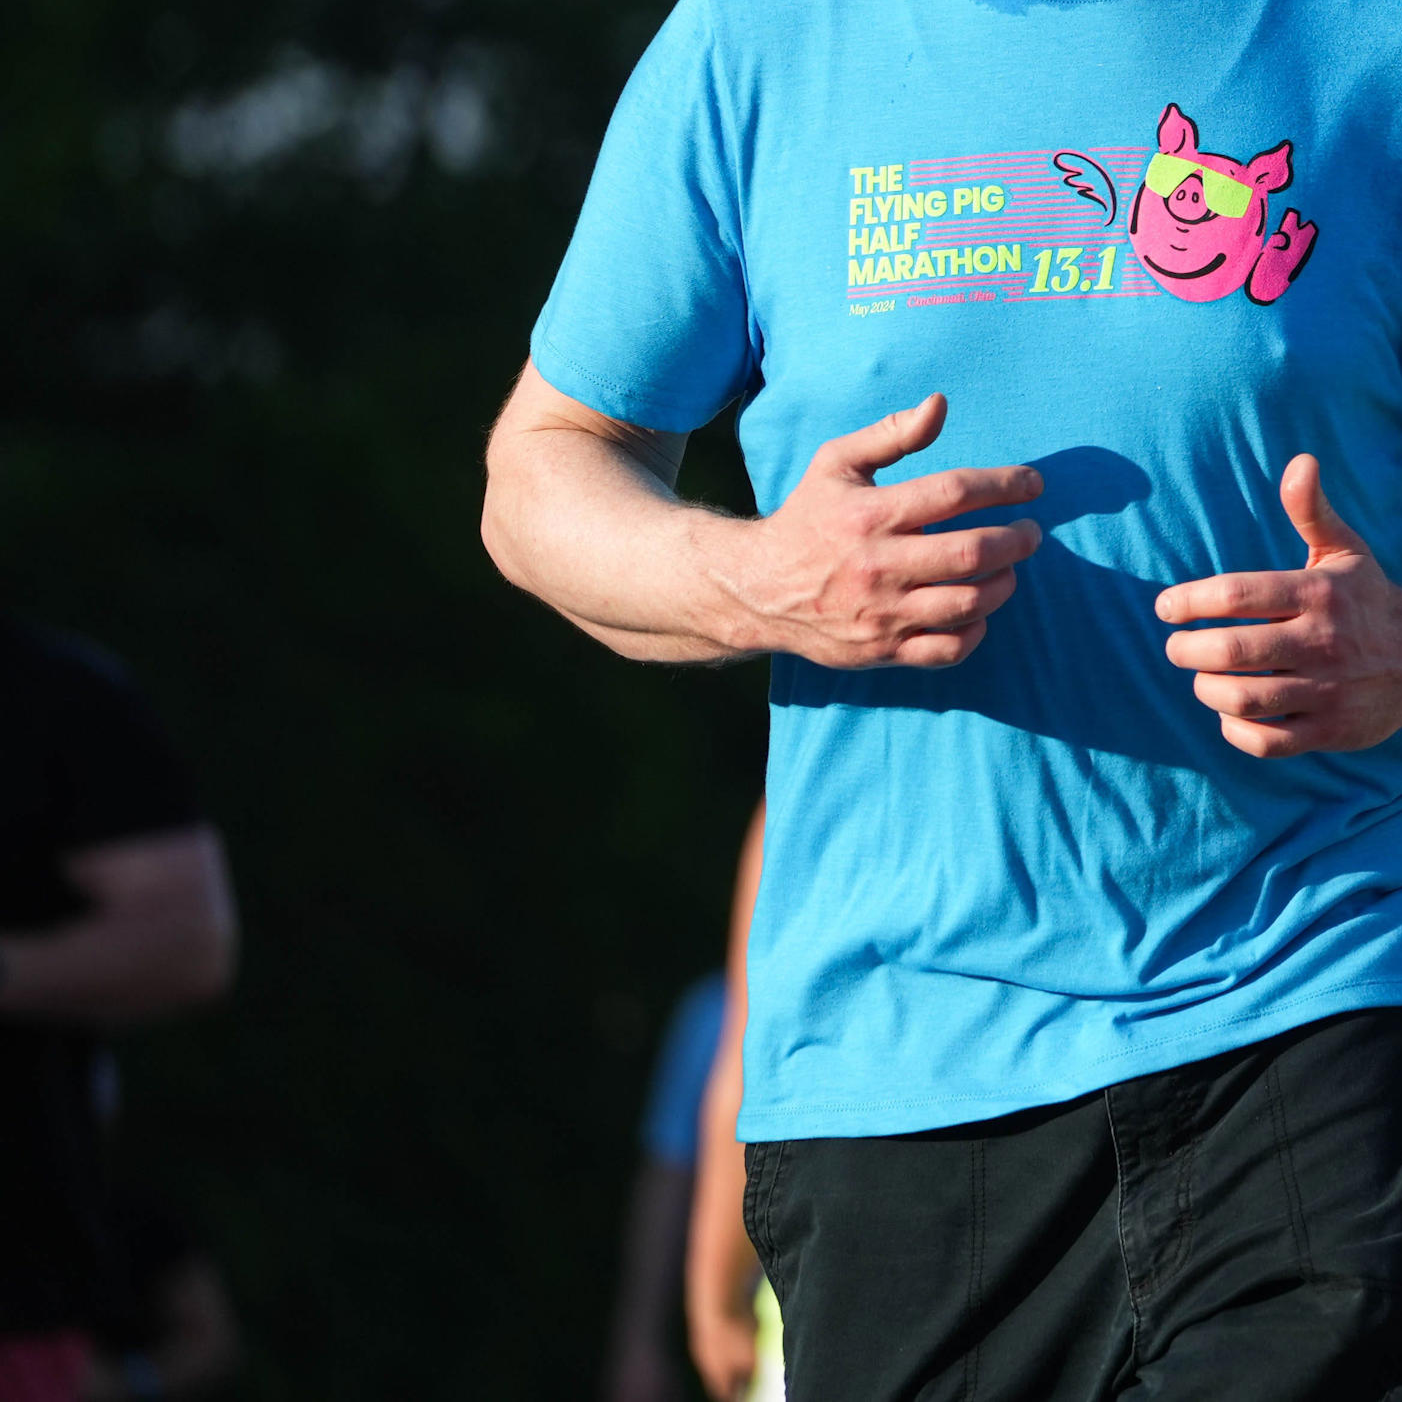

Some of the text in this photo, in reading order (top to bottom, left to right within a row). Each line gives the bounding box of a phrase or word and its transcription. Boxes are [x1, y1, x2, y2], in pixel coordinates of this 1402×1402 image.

[849, 164, 903, 194] THE
[849, 185, 1005, 226] FLYING PIG
[848, 222, 921, 256] HALF
[848, 244, 1022, 286] MARATHON
[1029, 246, 1117, 293] 13.1
[848, 300, 896, 318] May 2024
